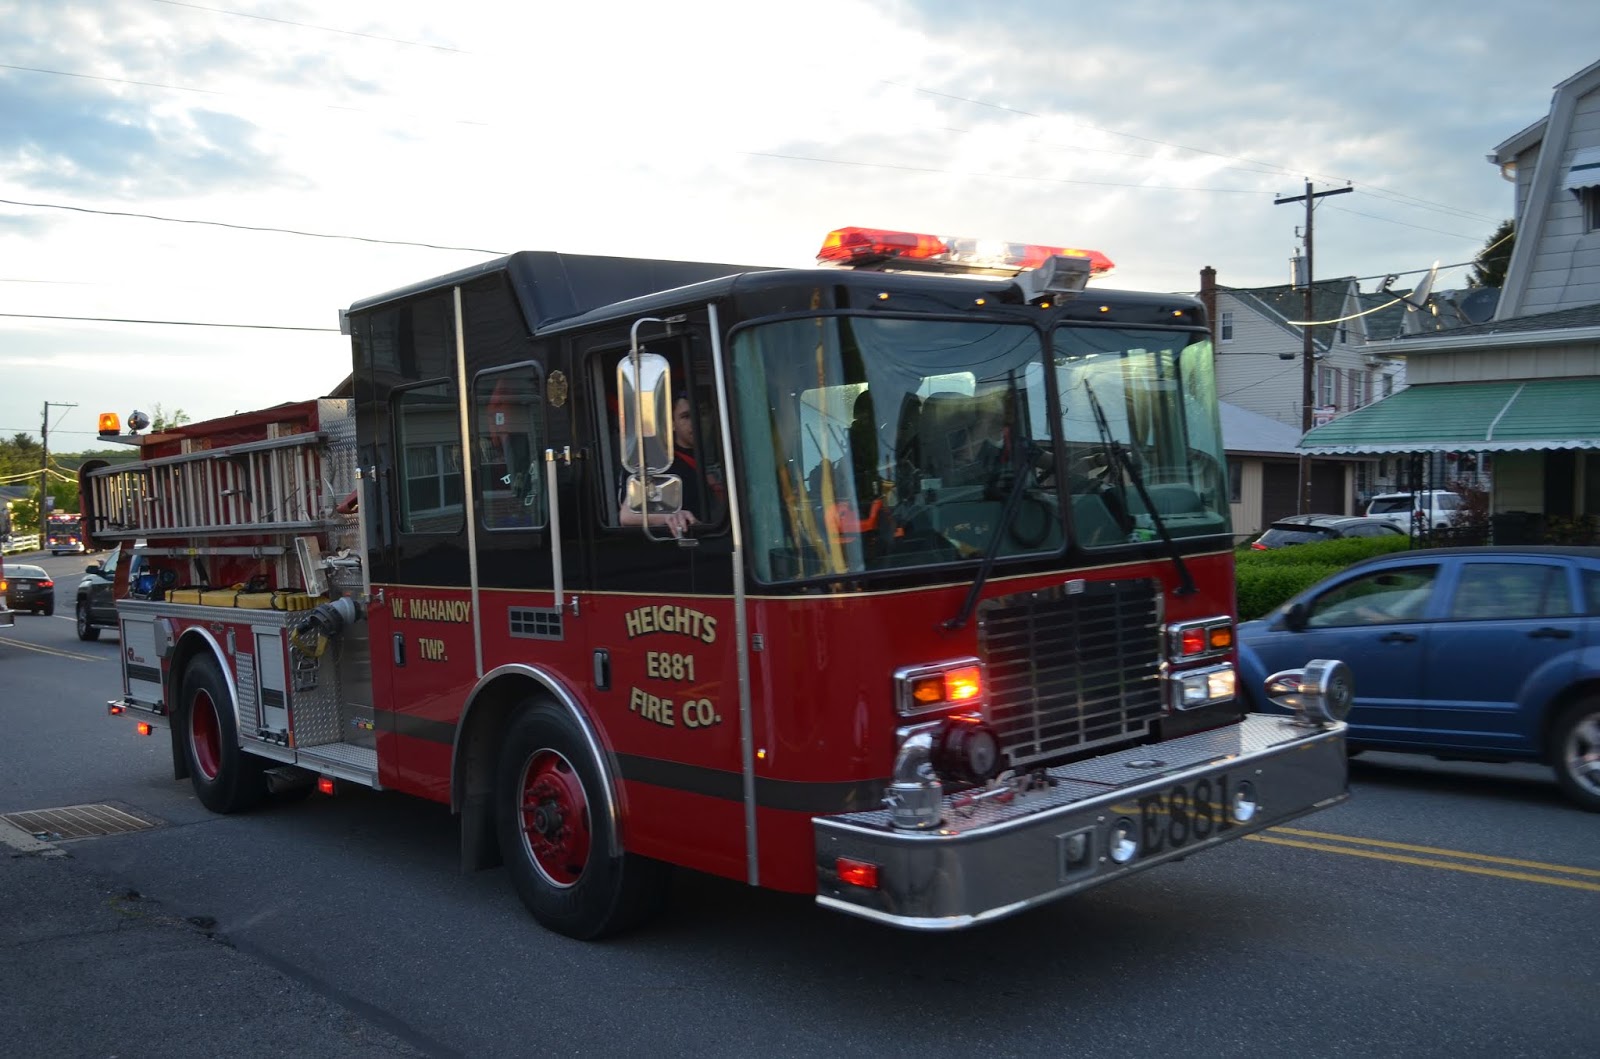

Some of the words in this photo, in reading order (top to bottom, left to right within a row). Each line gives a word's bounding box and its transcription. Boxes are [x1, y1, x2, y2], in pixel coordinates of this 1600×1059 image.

[392, 598, 406, 618] W.
[410, 599, 471, 622] MAHANOY
[625, 604, 718, 643] HEIGHTS
[418, 638, 448, 661] TWP.
[646, 652, 695, 681] E881
[630, 687, 675, 727] FIRE
[682, 698, 722, 728] CO.
[1138, 774, 1231, 857] E881
